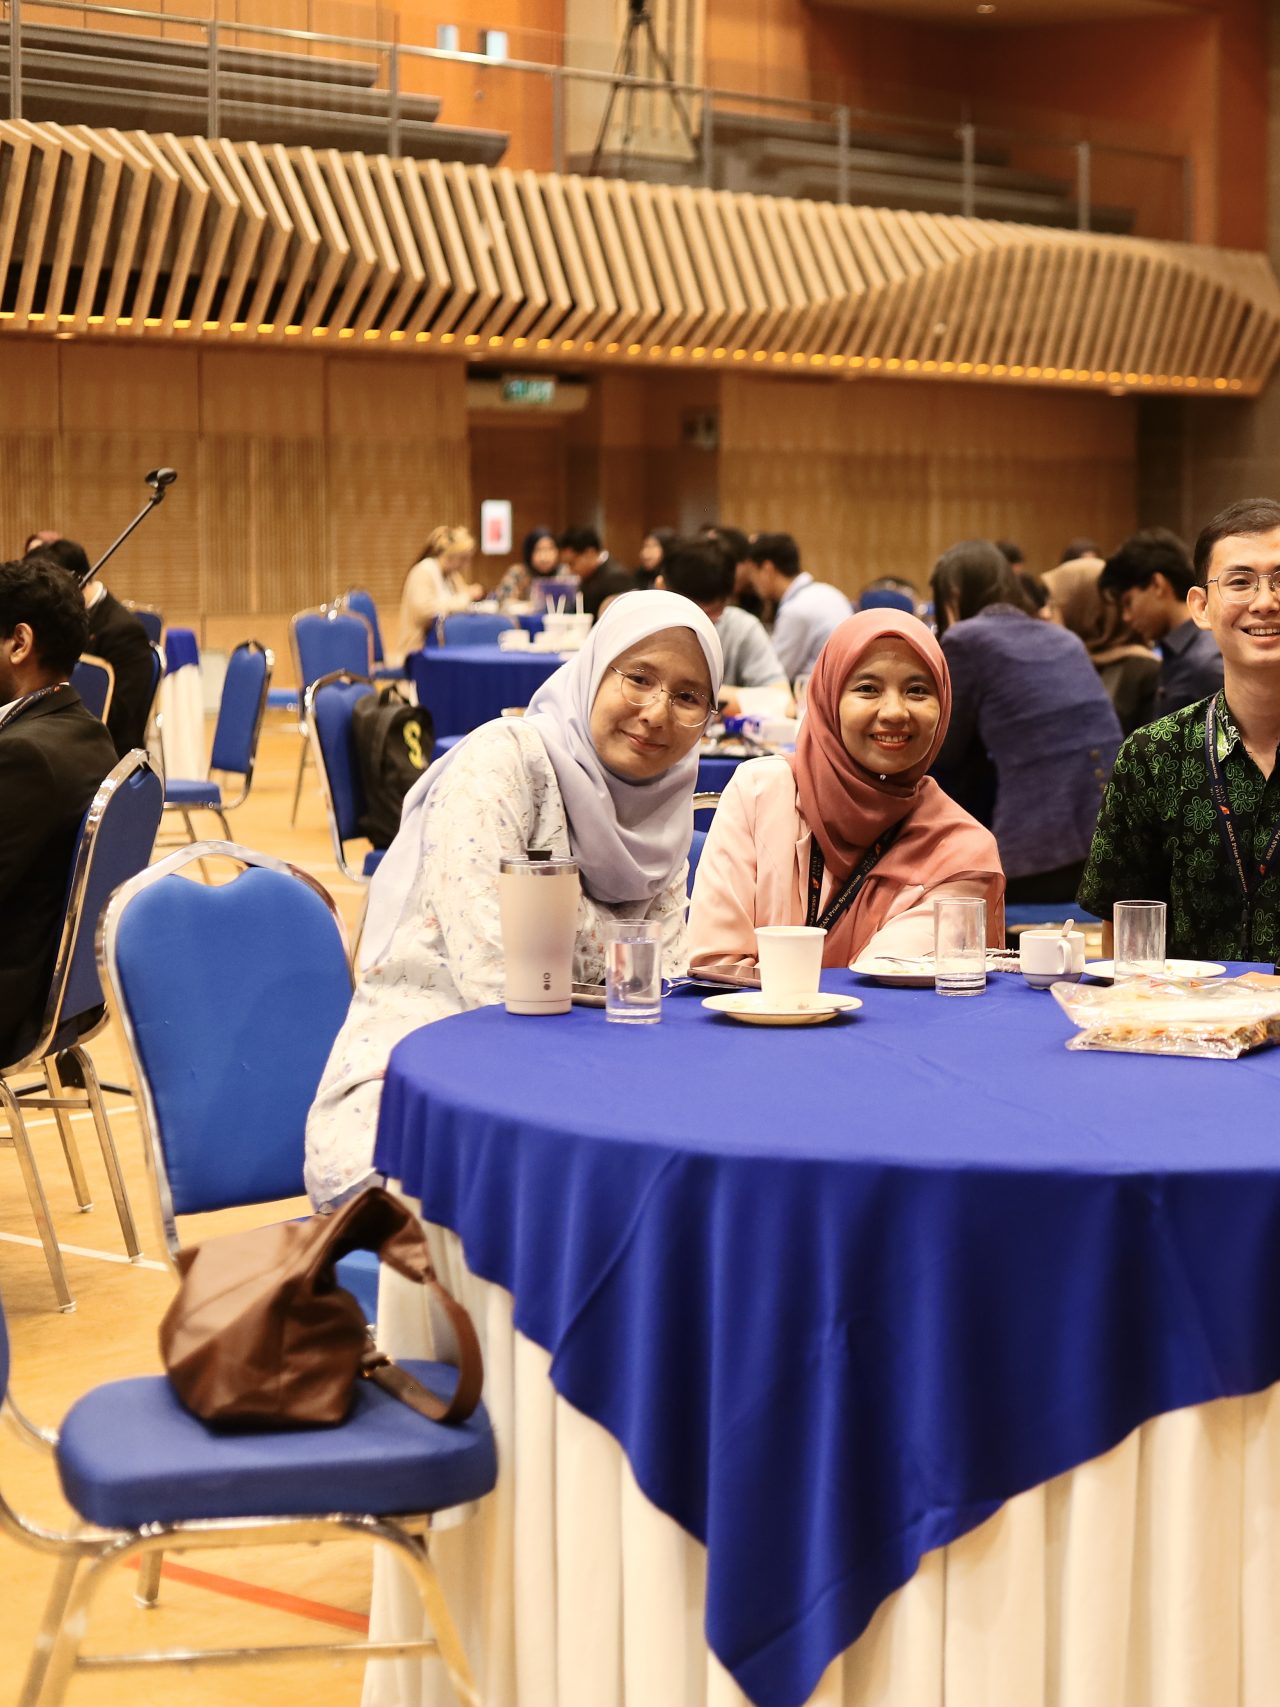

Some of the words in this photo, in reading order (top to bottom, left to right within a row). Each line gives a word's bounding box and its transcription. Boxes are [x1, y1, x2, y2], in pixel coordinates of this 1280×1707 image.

[1226, 820, 1235, 842] ASEAN
[1266, 840, 1277, 860] ASEAN
[828, 903, 840, 917] Prize
[839, 874, 861, 904] Symposium
